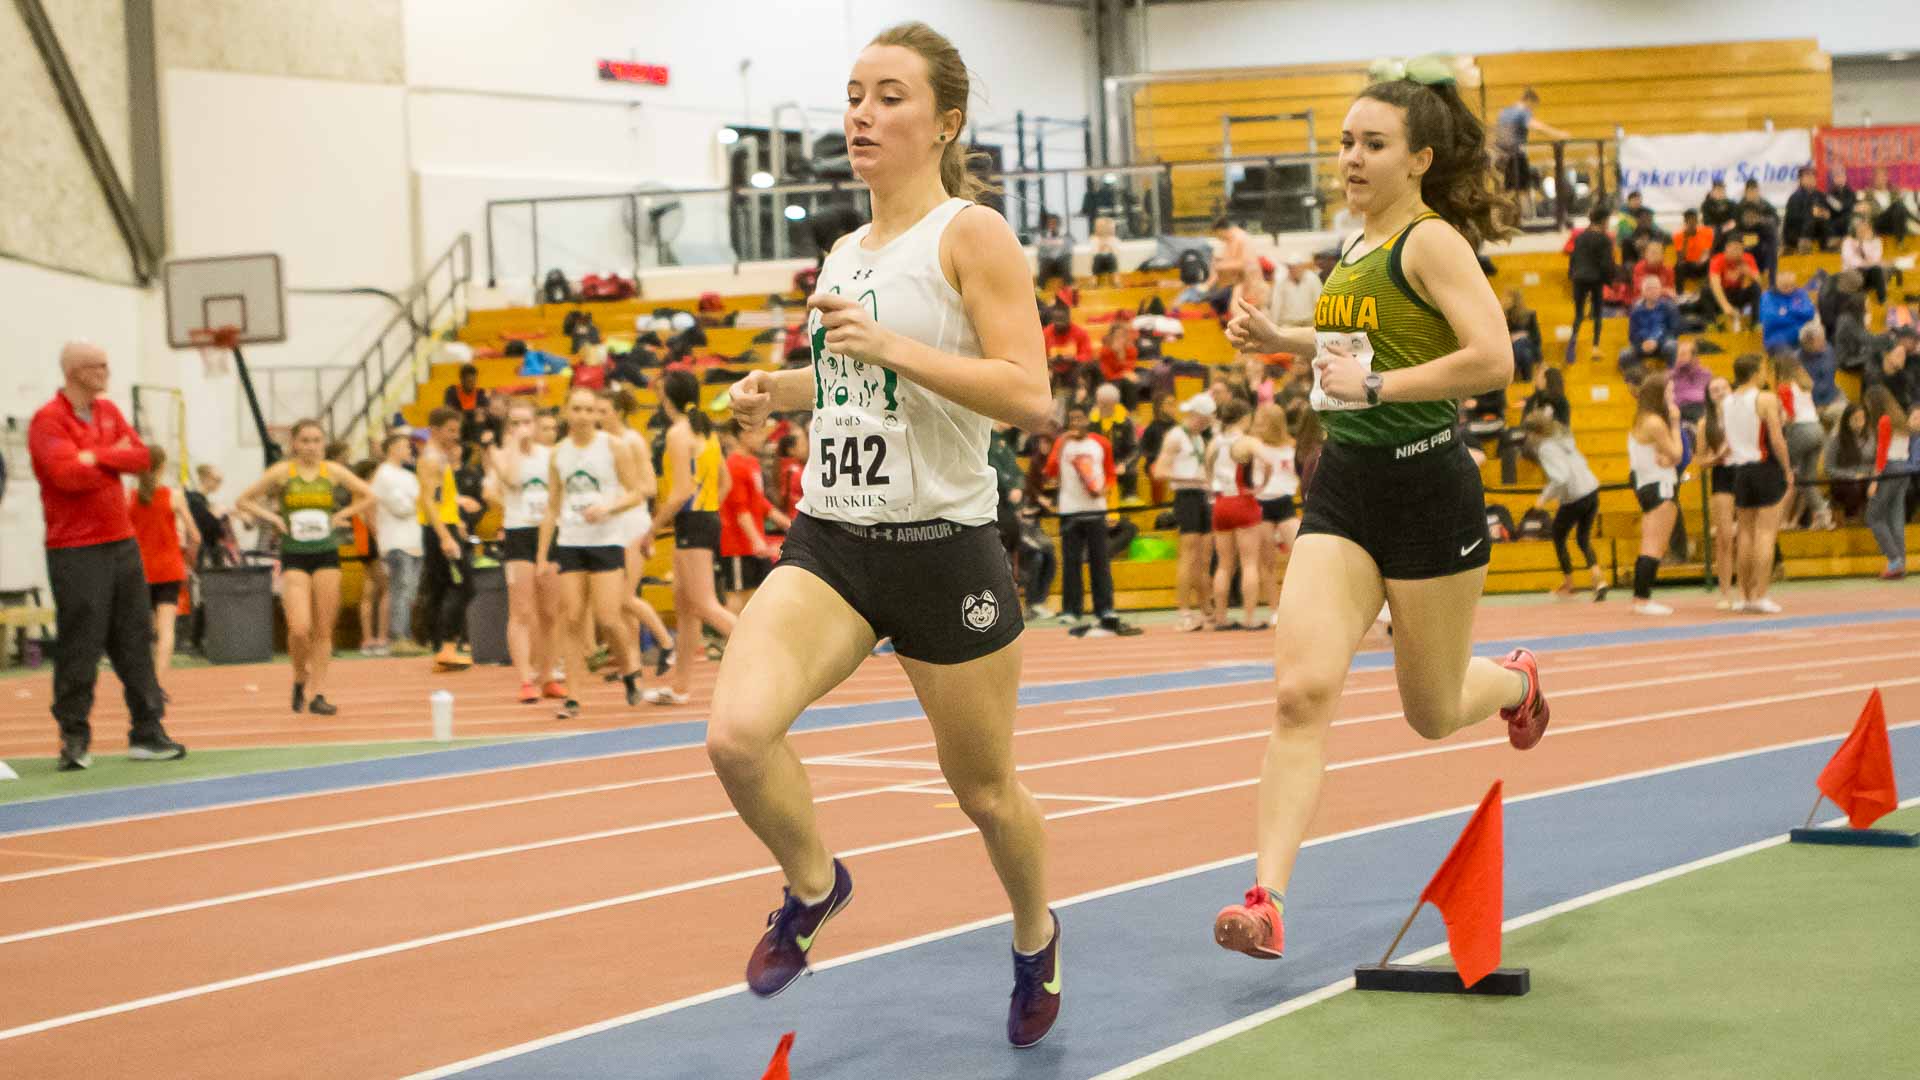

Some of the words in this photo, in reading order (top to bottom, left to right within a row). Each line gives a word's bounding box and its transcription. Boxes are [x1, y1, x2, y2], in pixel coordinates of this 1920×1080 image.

[1315, 294, 1380, 330] GINA
[1396, 439, 1429, 460] NIKE
[1430, 428, 1452, 448] PRO
[820, 434, 890, 488] 542
[825, 494, 887, 508] HUSKIES
[896, 522, 953, 542] ARMOUR
